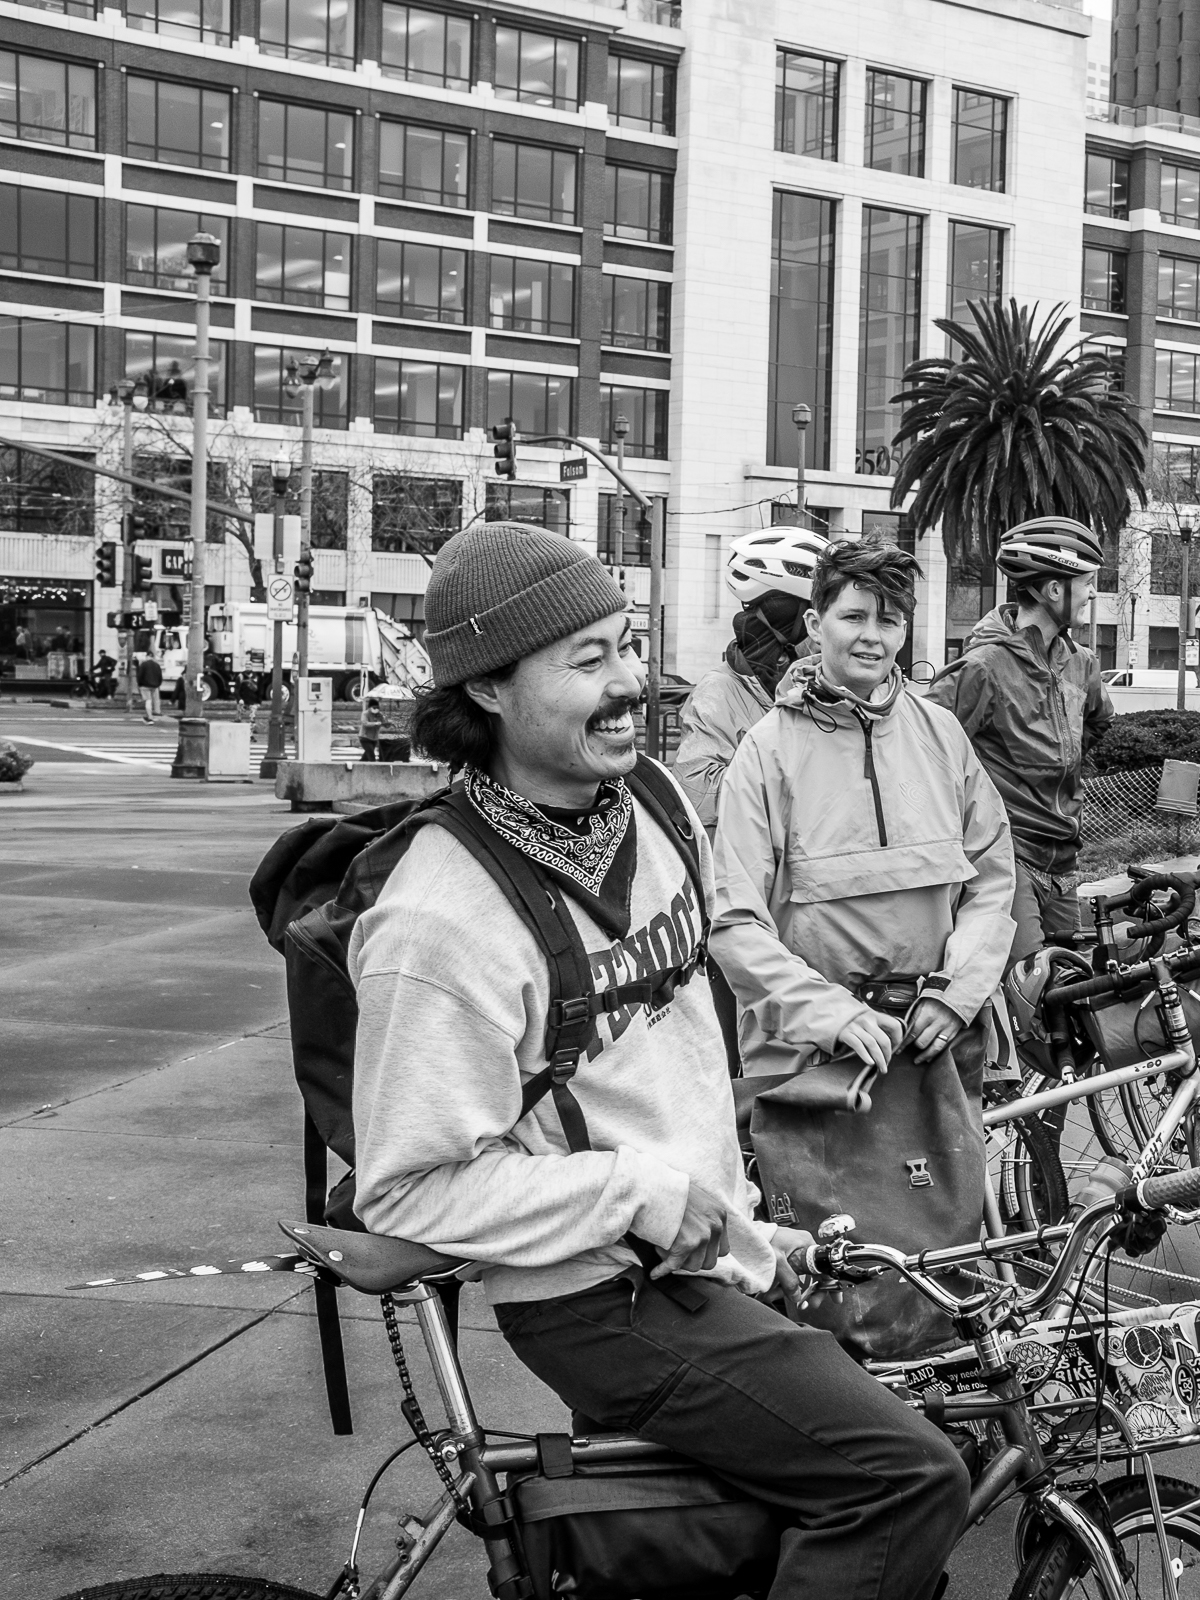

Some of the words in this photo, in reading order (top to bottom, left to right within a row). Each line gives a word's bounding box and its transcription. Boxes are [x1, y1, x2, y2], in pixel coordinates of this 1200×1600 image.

[563, 465, 584, 478] Folsom
[165, 555, 184, 569] GAP
[960, 1367, 980, 1379] need
[1055, 1365, 1097, 1382] BIKE
[956, 1382, 971, 1392] the
